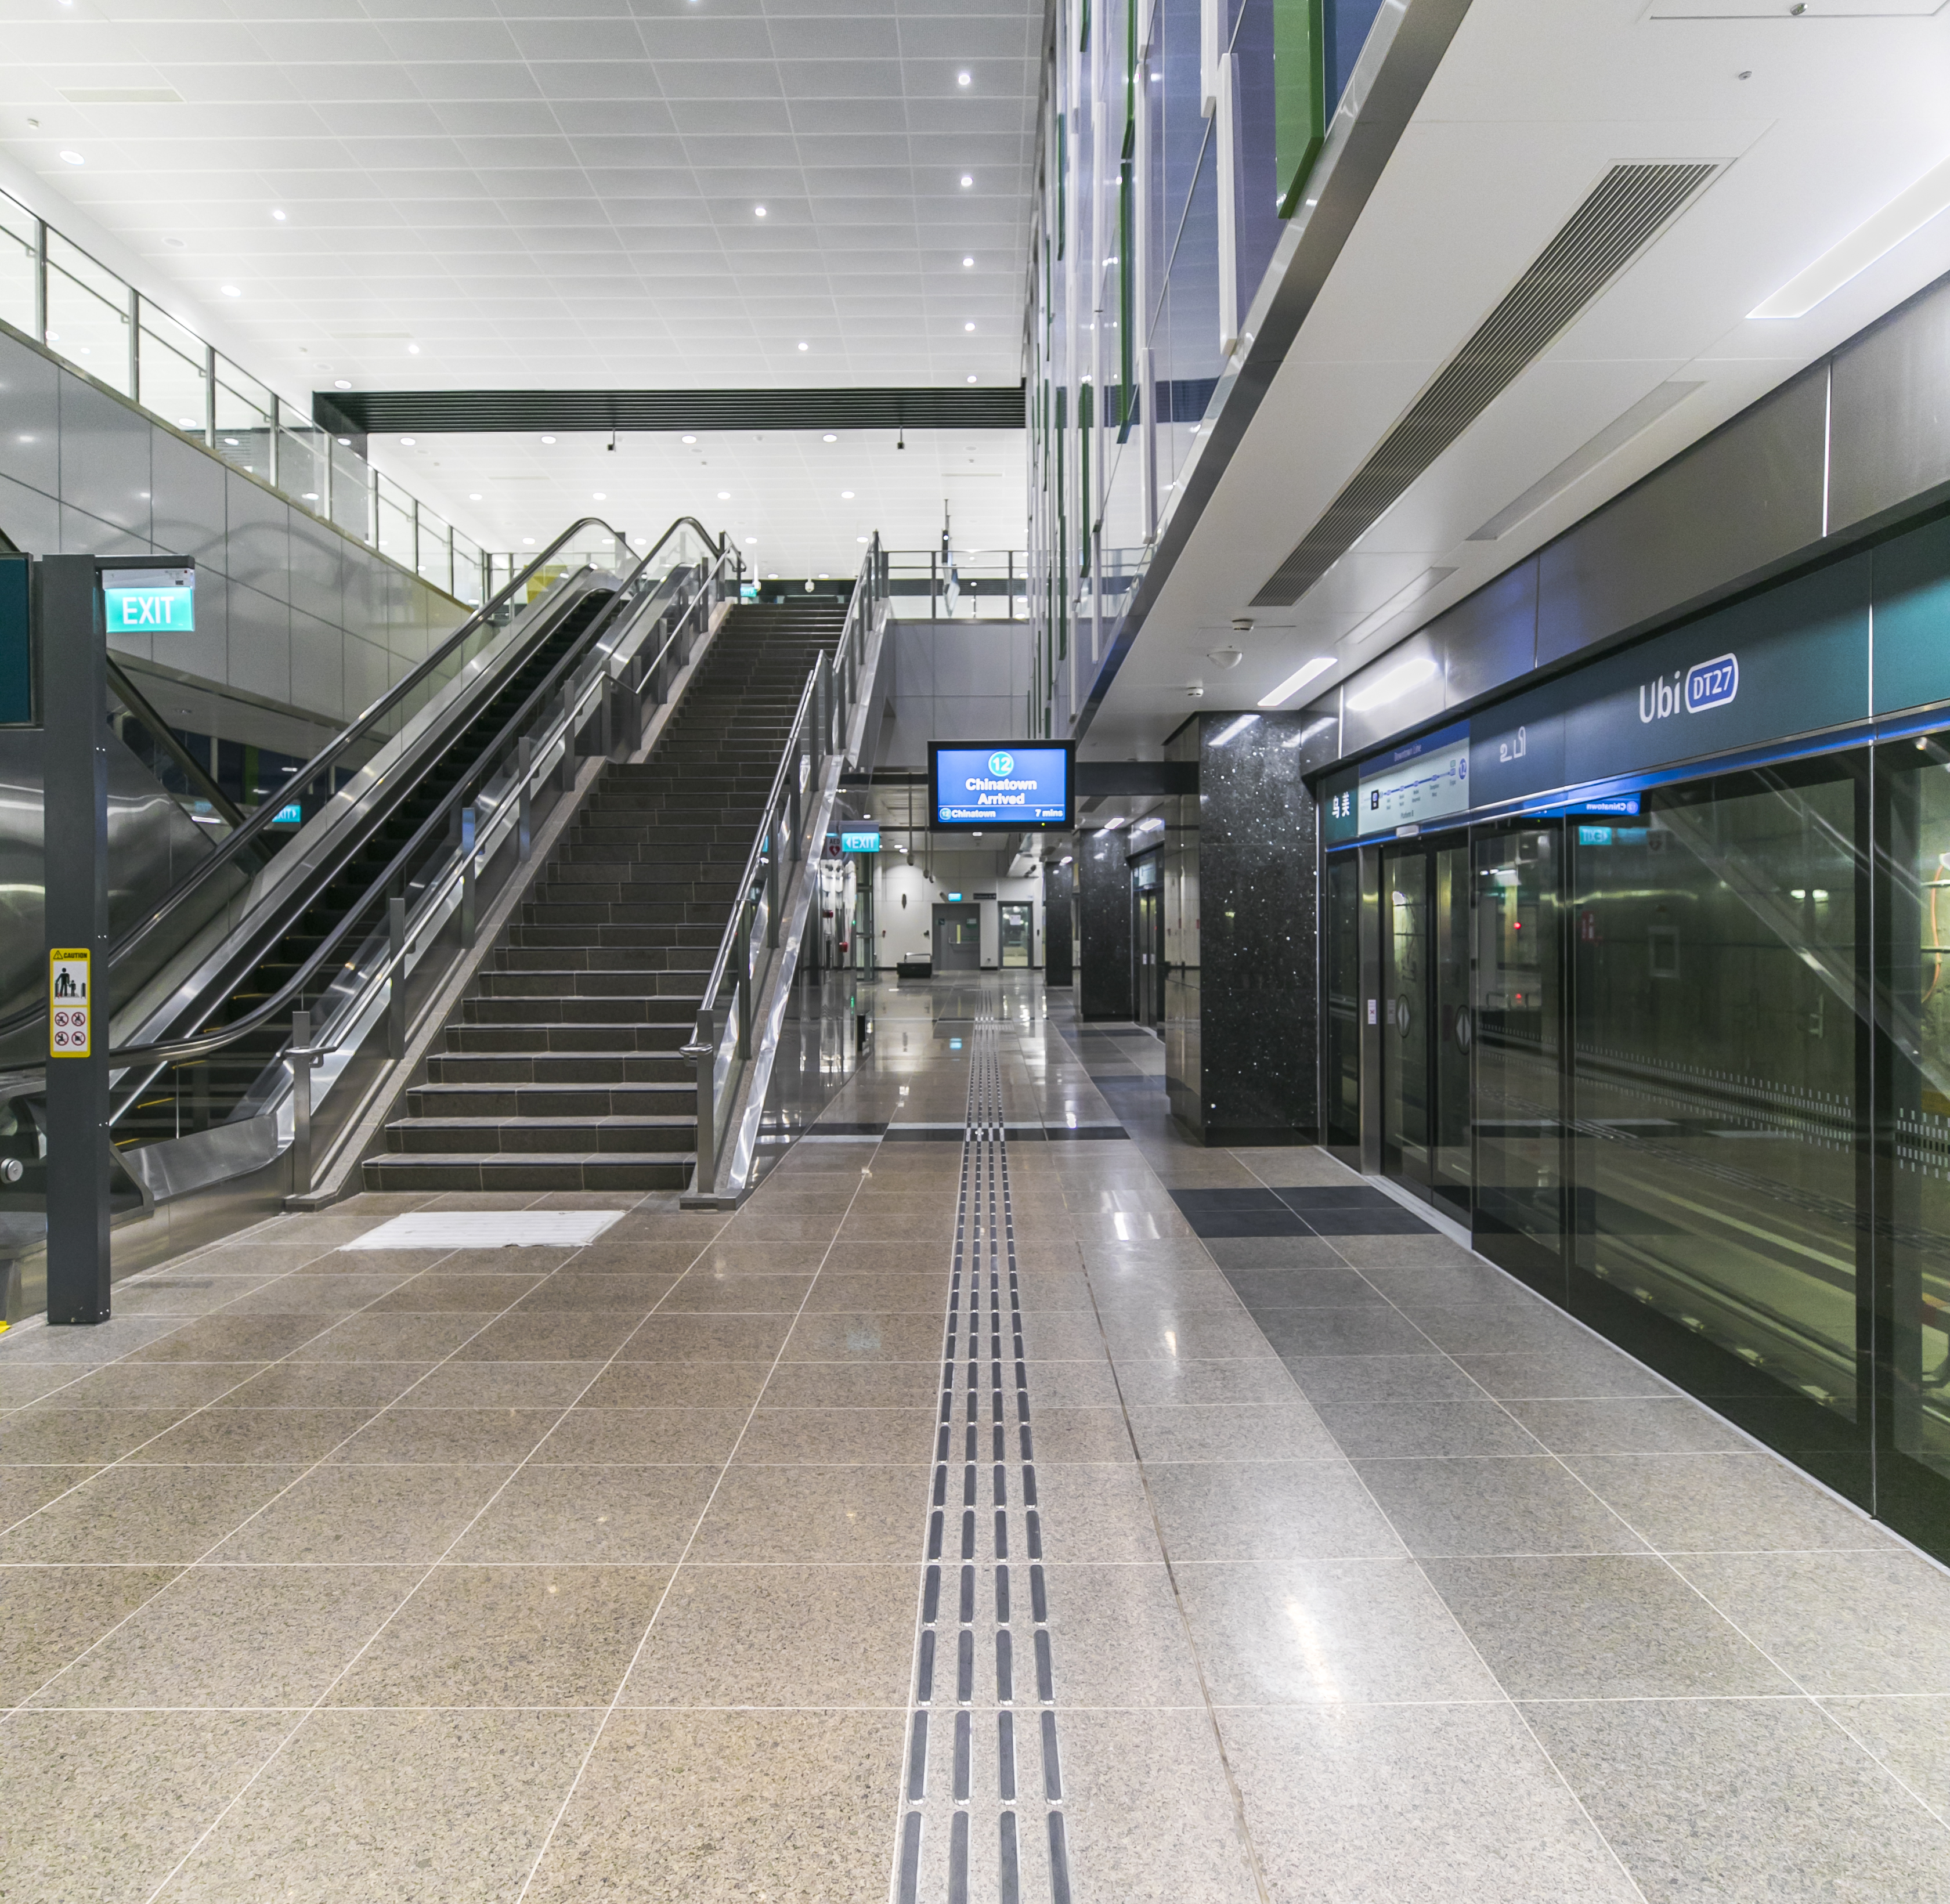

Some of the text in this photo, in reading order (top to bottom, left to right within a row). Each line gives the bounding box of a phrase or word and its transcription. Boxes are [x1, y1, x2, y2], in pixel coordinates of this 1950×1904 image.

[122, 596, 174, 624] EXIT
[1640, 666, 1732, 724] Ubi DT27
[993, 757, 1011, 771] 12
[965, 778, 1038, 791] Chinatown
[977, 793, 1025, 805] Arrived
[952, 809, 996, 818] Chinatown
[1035, 808, 1041, 817] 7
[1042, 808, 1063, 817] mins
[852, 836, 875, 849] EXIT
